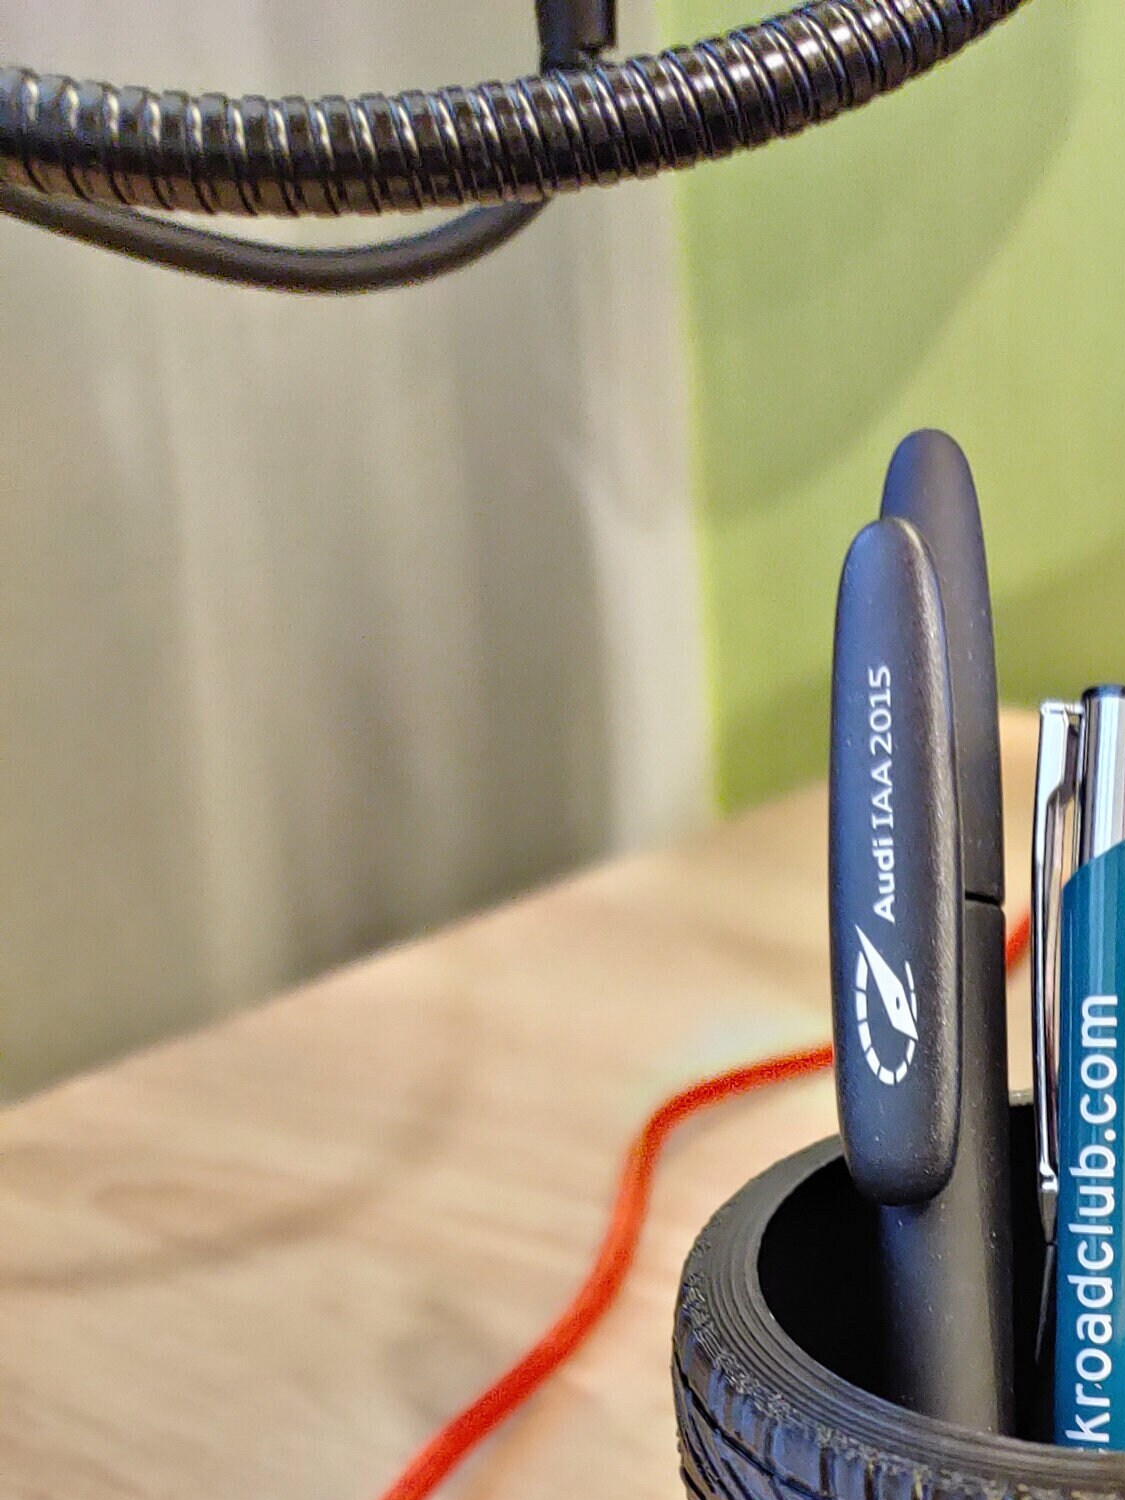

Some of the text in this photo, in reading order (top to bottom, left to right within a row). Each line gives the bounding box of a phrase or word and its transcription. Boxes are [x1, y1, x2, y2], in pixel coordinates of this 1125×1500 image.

[868, 664, 896, 923] Audi IAA 2015
[1064, 994, 1119, 1453] kroadclub.com
